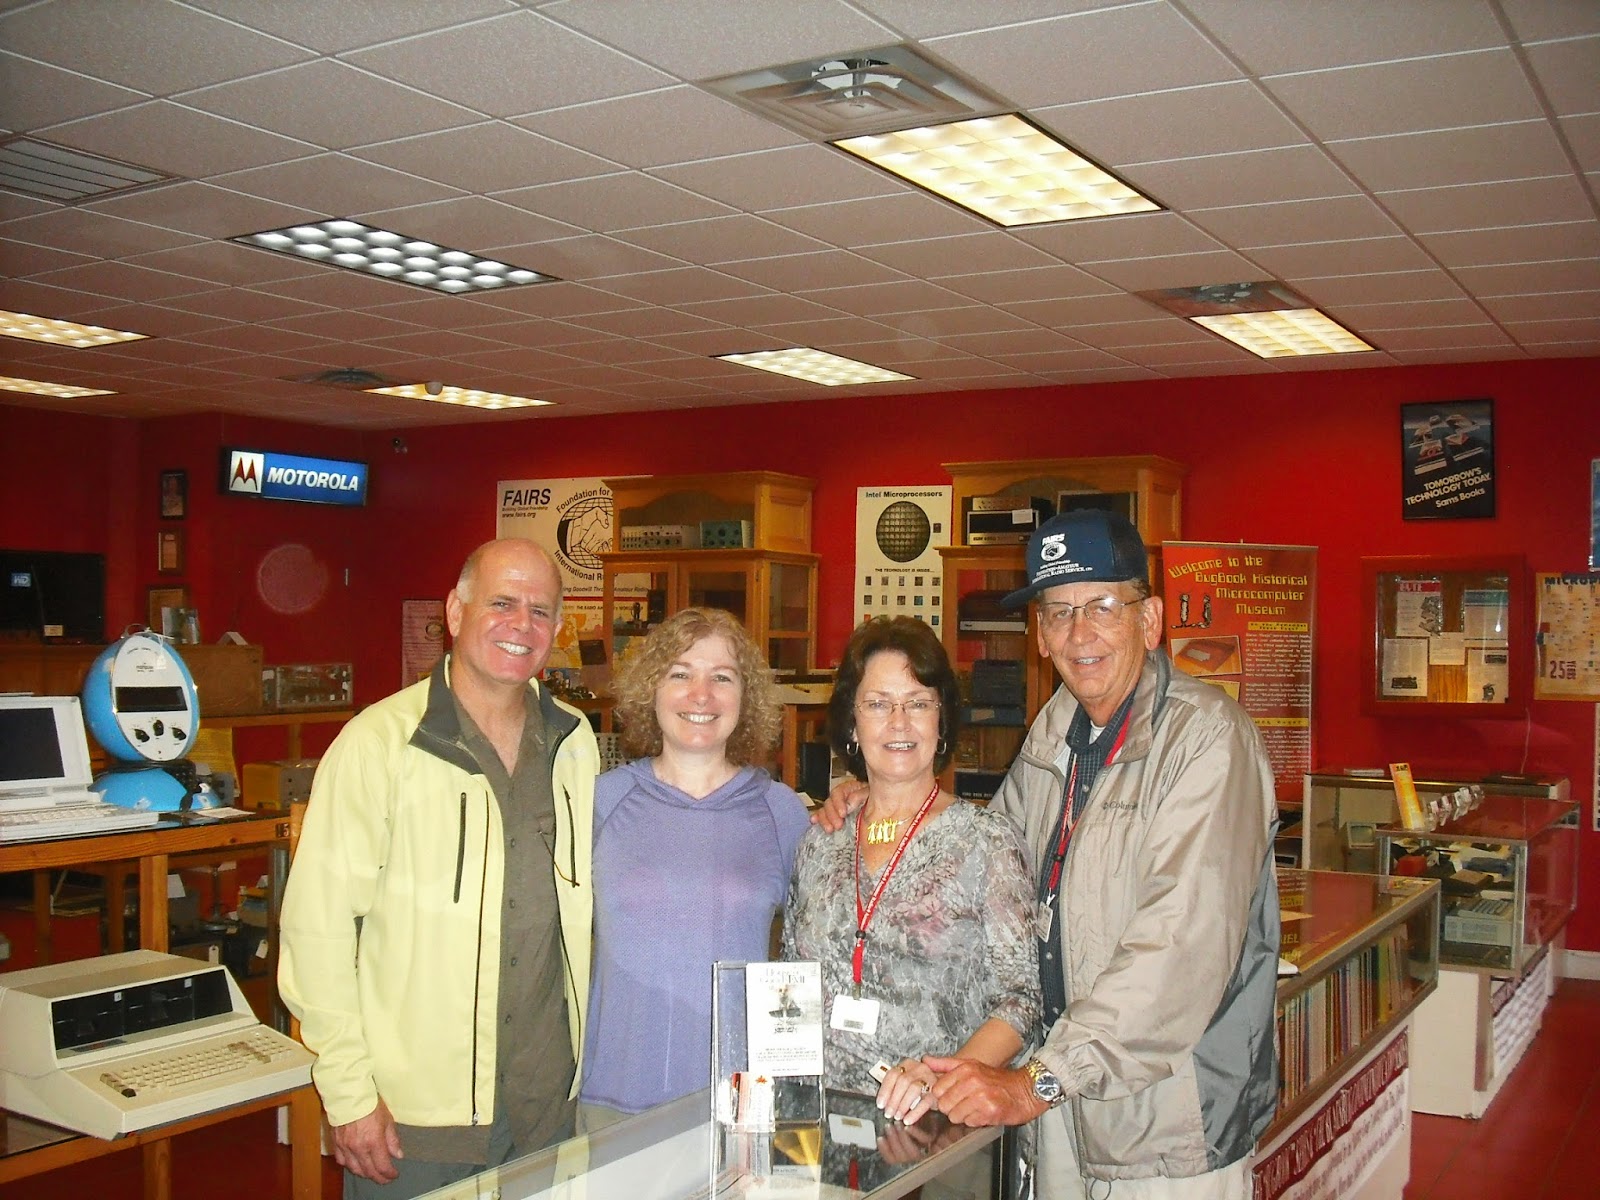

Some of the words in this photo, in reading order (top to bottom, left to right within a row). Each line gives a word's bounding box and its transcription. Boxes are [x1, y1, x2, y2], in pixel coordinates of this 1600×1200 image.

[267, 466, 359, 491] MOTOROLA
[1423, 467, 1482, 490] TOMORROW'S
[503, 488, 551, 506] FAIRS
[556, 489, 598, 514] Foundation
[599, 487, 610, 496] for
[1405, 482, 1461, 505] TECHNOLOGY
[1435, 496, 1460, 508] Sams
[1459, 488, 1485, 500] Books
[554, 549, 595, 581] International
[1168, 559, 1222, 578] Welcome
[1228, 556, 1239, 567] to
[1245, 555, 1263, 566] the
[1195, 572, 1247, 586] BugBook
[1252, 573, 1308, 586] Historical
[1545, 576, 1600, 585] MICROP
[1216, 587, 1305, 602] Microcomputer
[1236, 603, 1286, 615] Museum
[1549, 660, 1566, 680] 25
